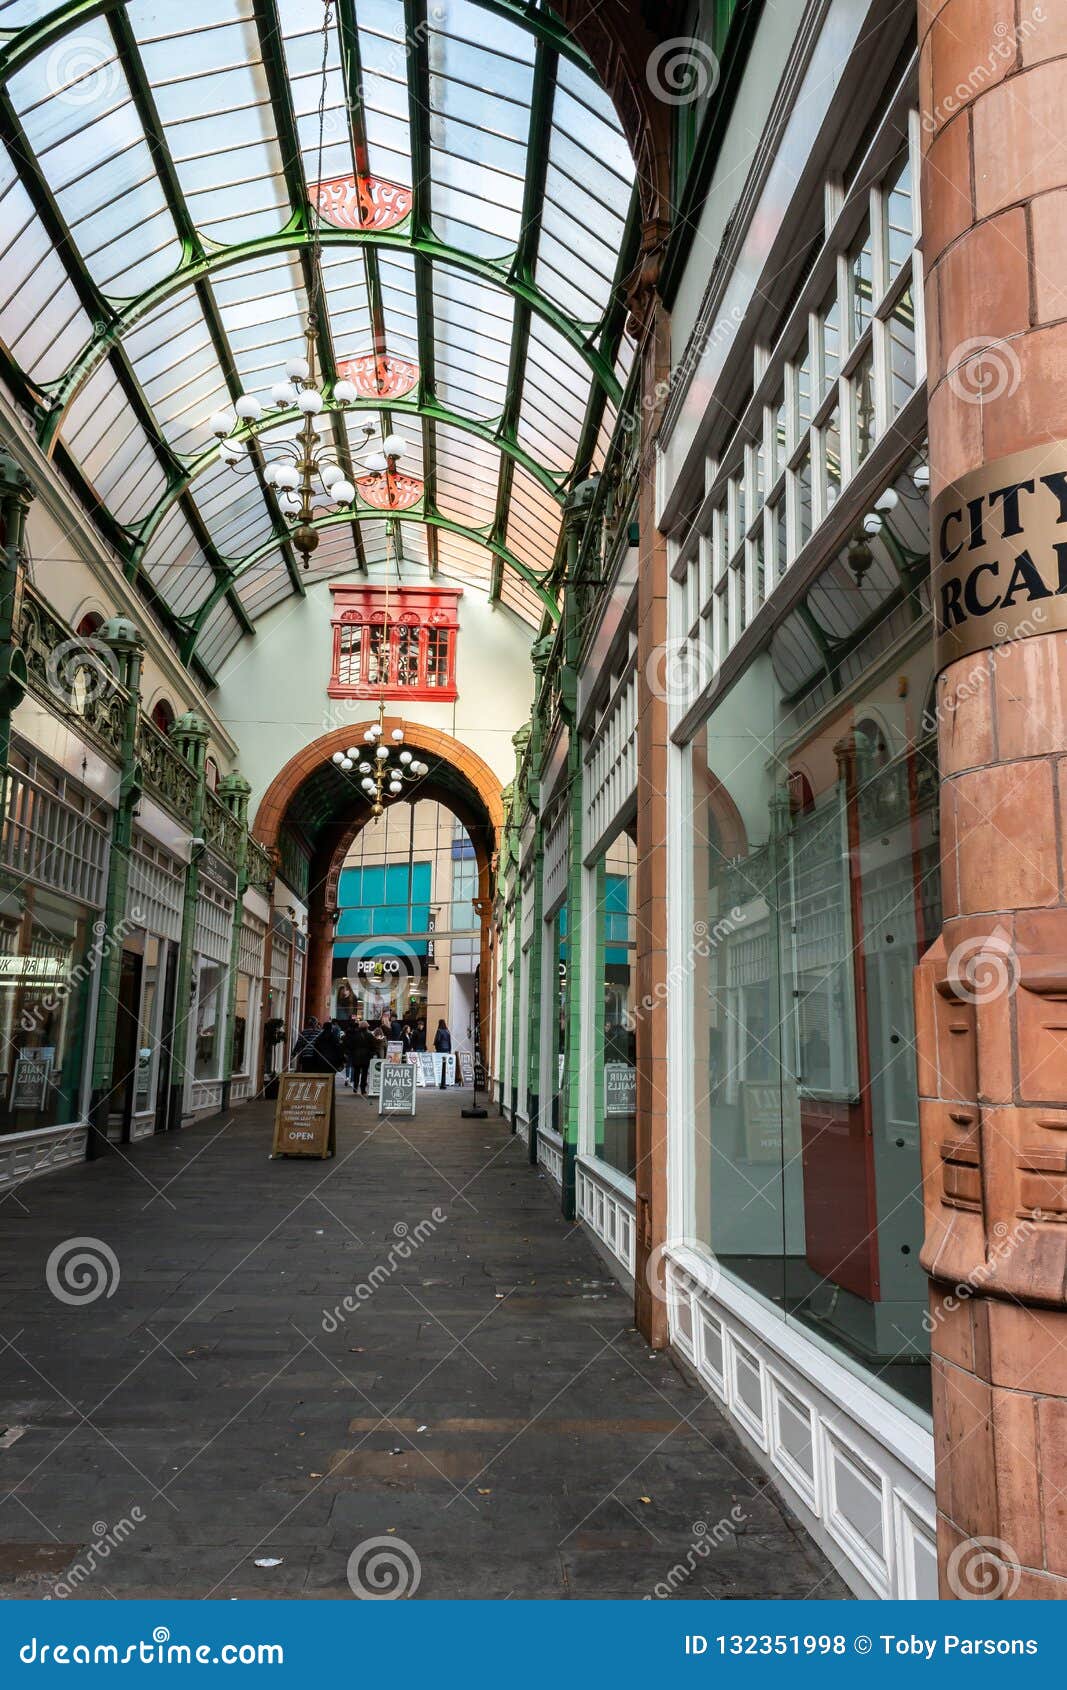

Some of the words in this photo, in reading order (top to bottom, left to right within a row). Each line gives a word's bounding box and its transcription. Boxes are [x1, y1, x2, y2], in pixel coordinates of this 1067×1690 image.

[386, 1069, 410, 1078] HAIR
[384, 1078, 412, 1087] NAILS
[286, 1082, 326, 1103] TILT
[288, 1132, 314, 1140] OPEN
